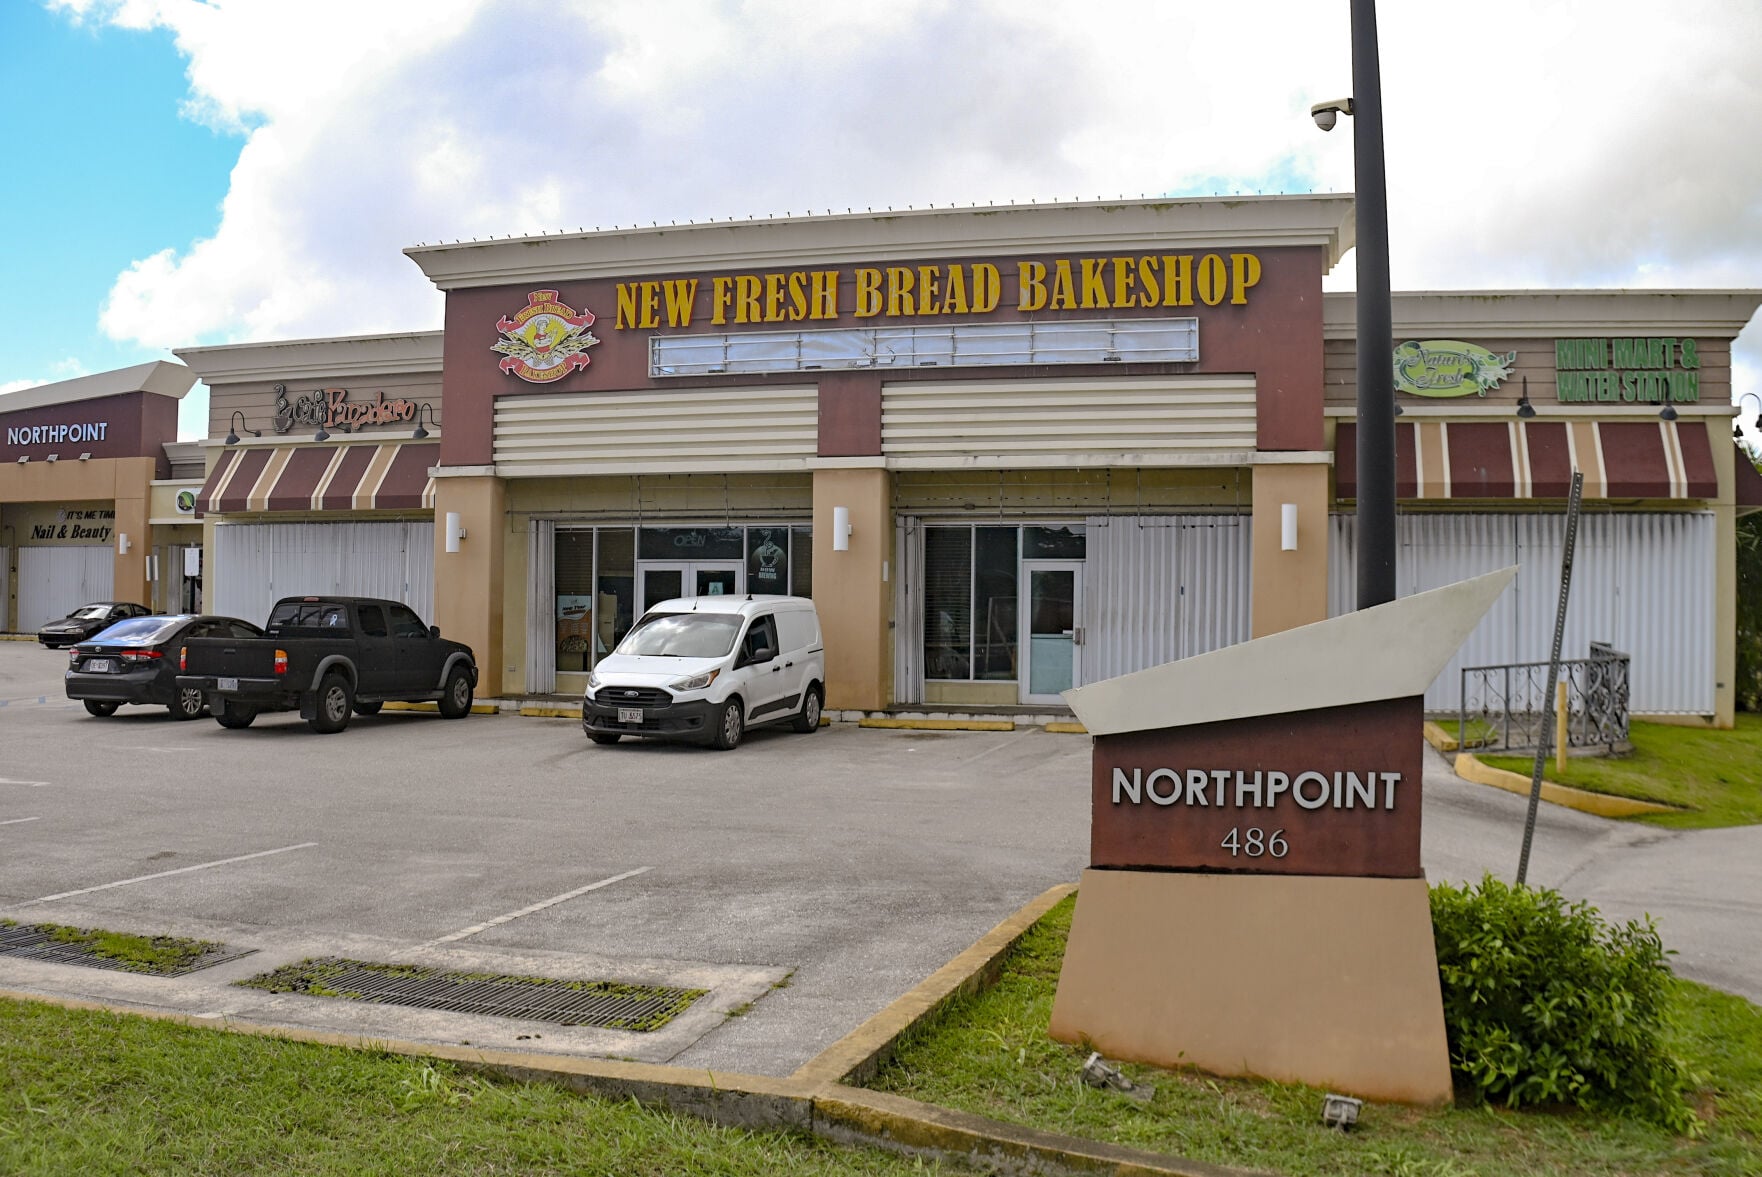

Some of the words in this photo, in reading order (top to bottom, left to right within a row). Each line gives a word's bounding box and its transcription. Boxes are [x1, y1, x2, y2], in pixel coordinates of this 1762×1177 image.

[614, 279, 698, 330] NEW
[710, 270, 840, 325] FRESH
[853, 262, 1001, 319] BREAD
[1016, 253, 1262, 312] BAKESHOP
[1555, 337, 1609, 369] MINI
[1612, 337, 1678, 369] MART
[1680, 338, 1700, 369] &
[1556, 370, 1620, 402] WATER
[1622, 370, 1699, 402] STATION
[324, 388, 417, 431] Panadero
[7, 422, 108, 445] NORTHPOINT
[84, 510, 98, 520] ME
[31, 525, 56, 540] Nail
[57, 524, 68, 539] &
[70, 524, 112, 542] Beauty
[674, 534, 706, 548] OPEN
[1112, 767, 1401, 810] NORTHPOINT
[1221, 827, 1289, 857] 486
